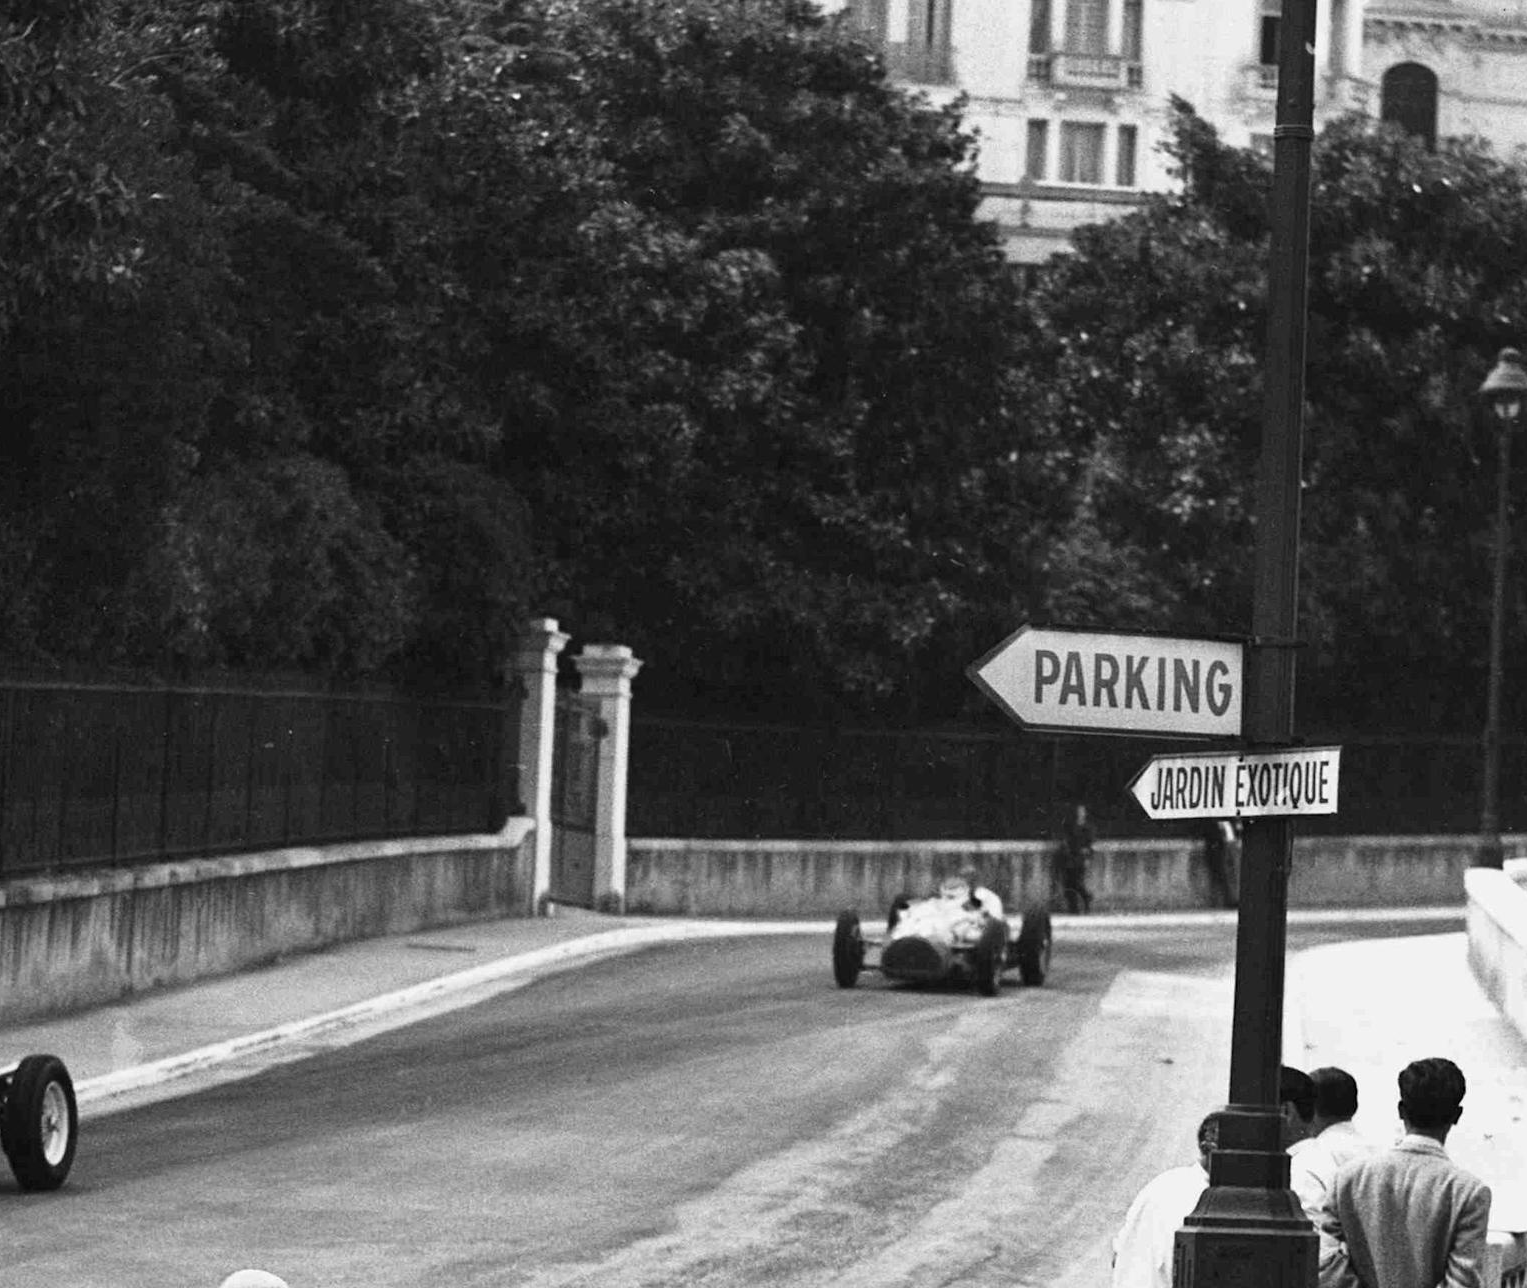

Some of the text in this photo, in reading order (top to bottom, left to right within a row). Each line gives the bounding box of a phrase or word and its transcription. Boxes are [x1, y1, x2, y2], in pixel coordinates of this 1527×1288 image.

[1034, 650, 1233, 717] PARKING
[1150, 761, 1330, 811] JARDIN EXOTIQUE
